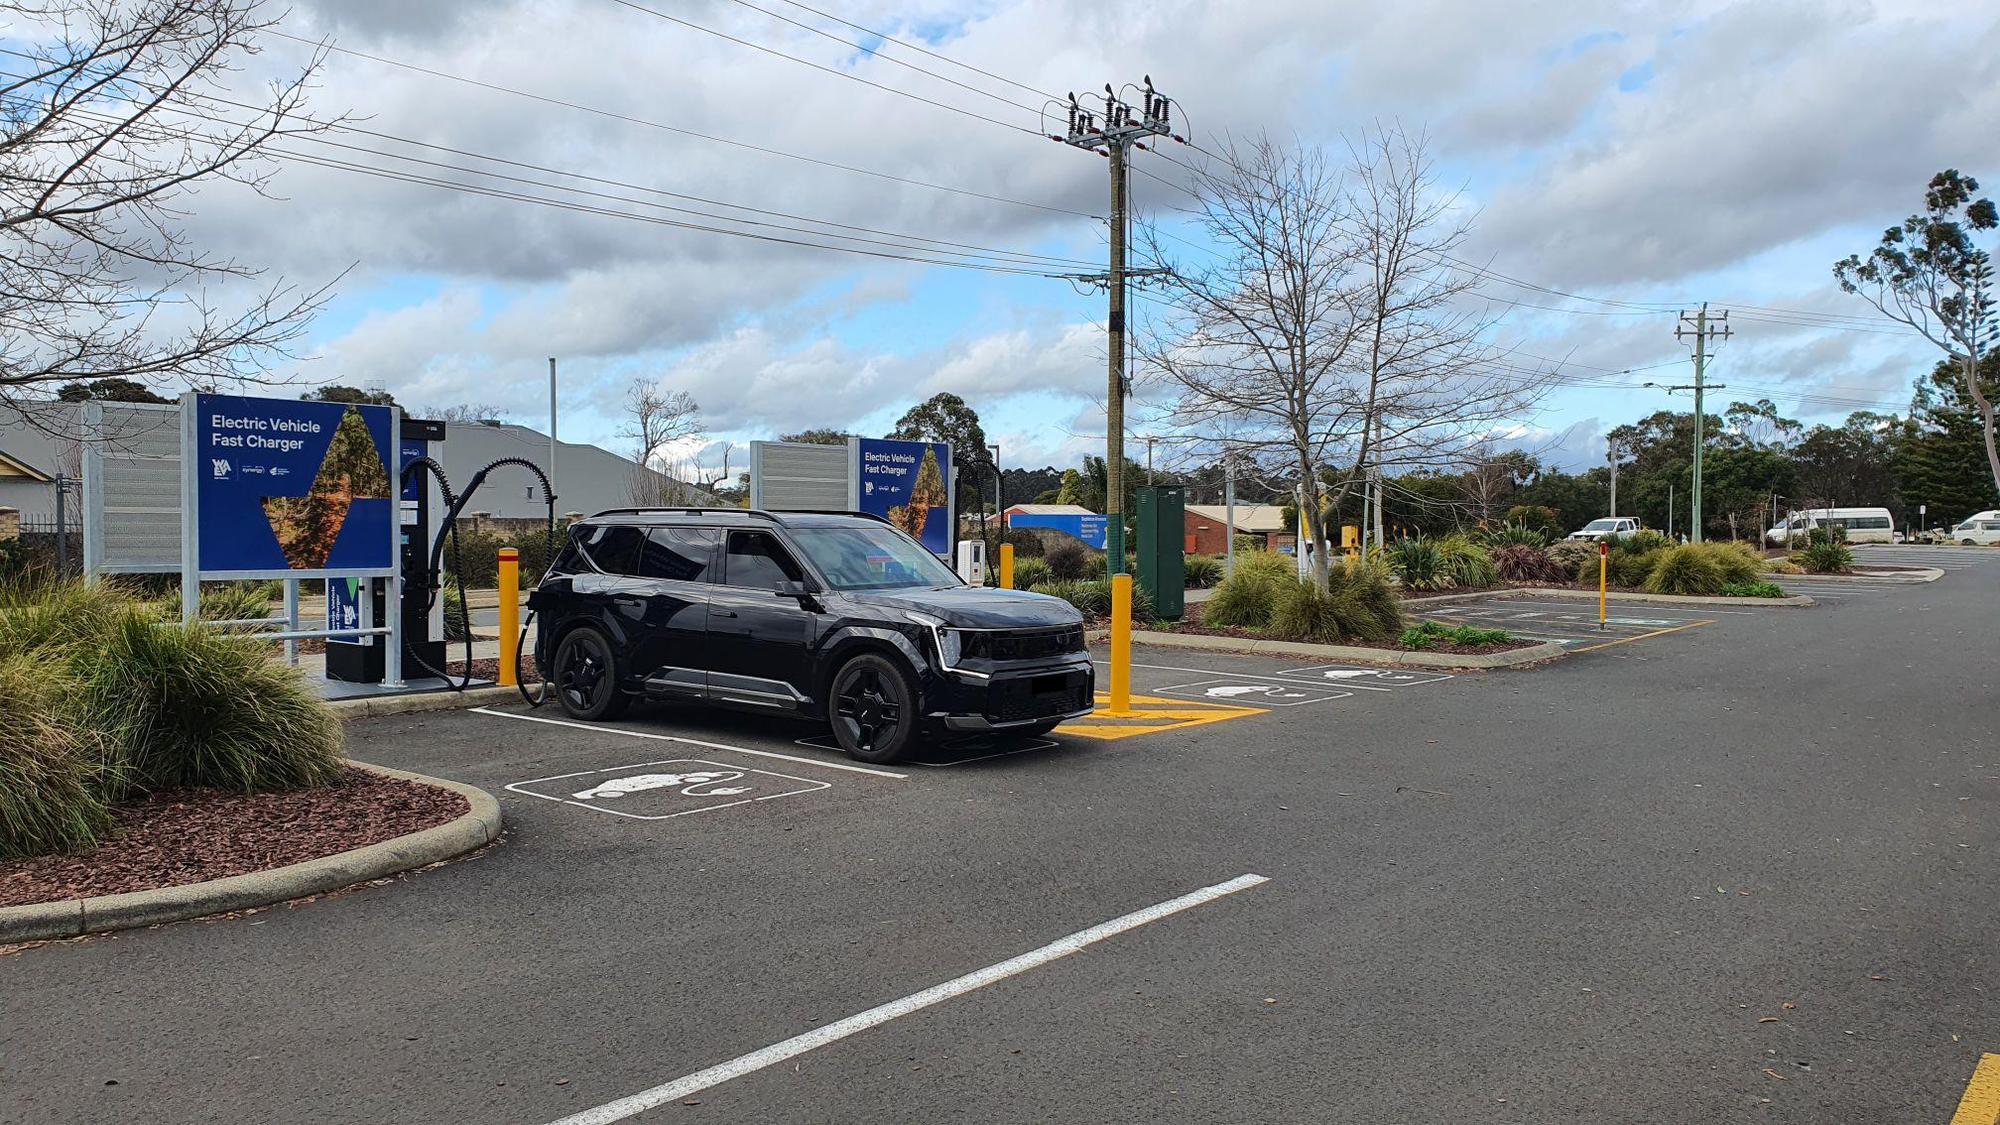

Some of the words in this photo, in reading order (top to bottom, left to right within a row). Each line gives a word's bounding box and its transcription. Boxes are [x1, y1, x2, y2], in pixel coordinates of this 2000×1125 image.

[212, 414, 268, 431] Electric
[270, 417, 321, 433] Vehicle
[212, 433, 243, 448] Fast
[246, 434, 304, 453] Charger
[865, 452, 890, 462] Electric
[891, 453, 915, 463] Vehicle
[865, 464, 879, 473] Fast
[881, 465, 907, 476] Charger
